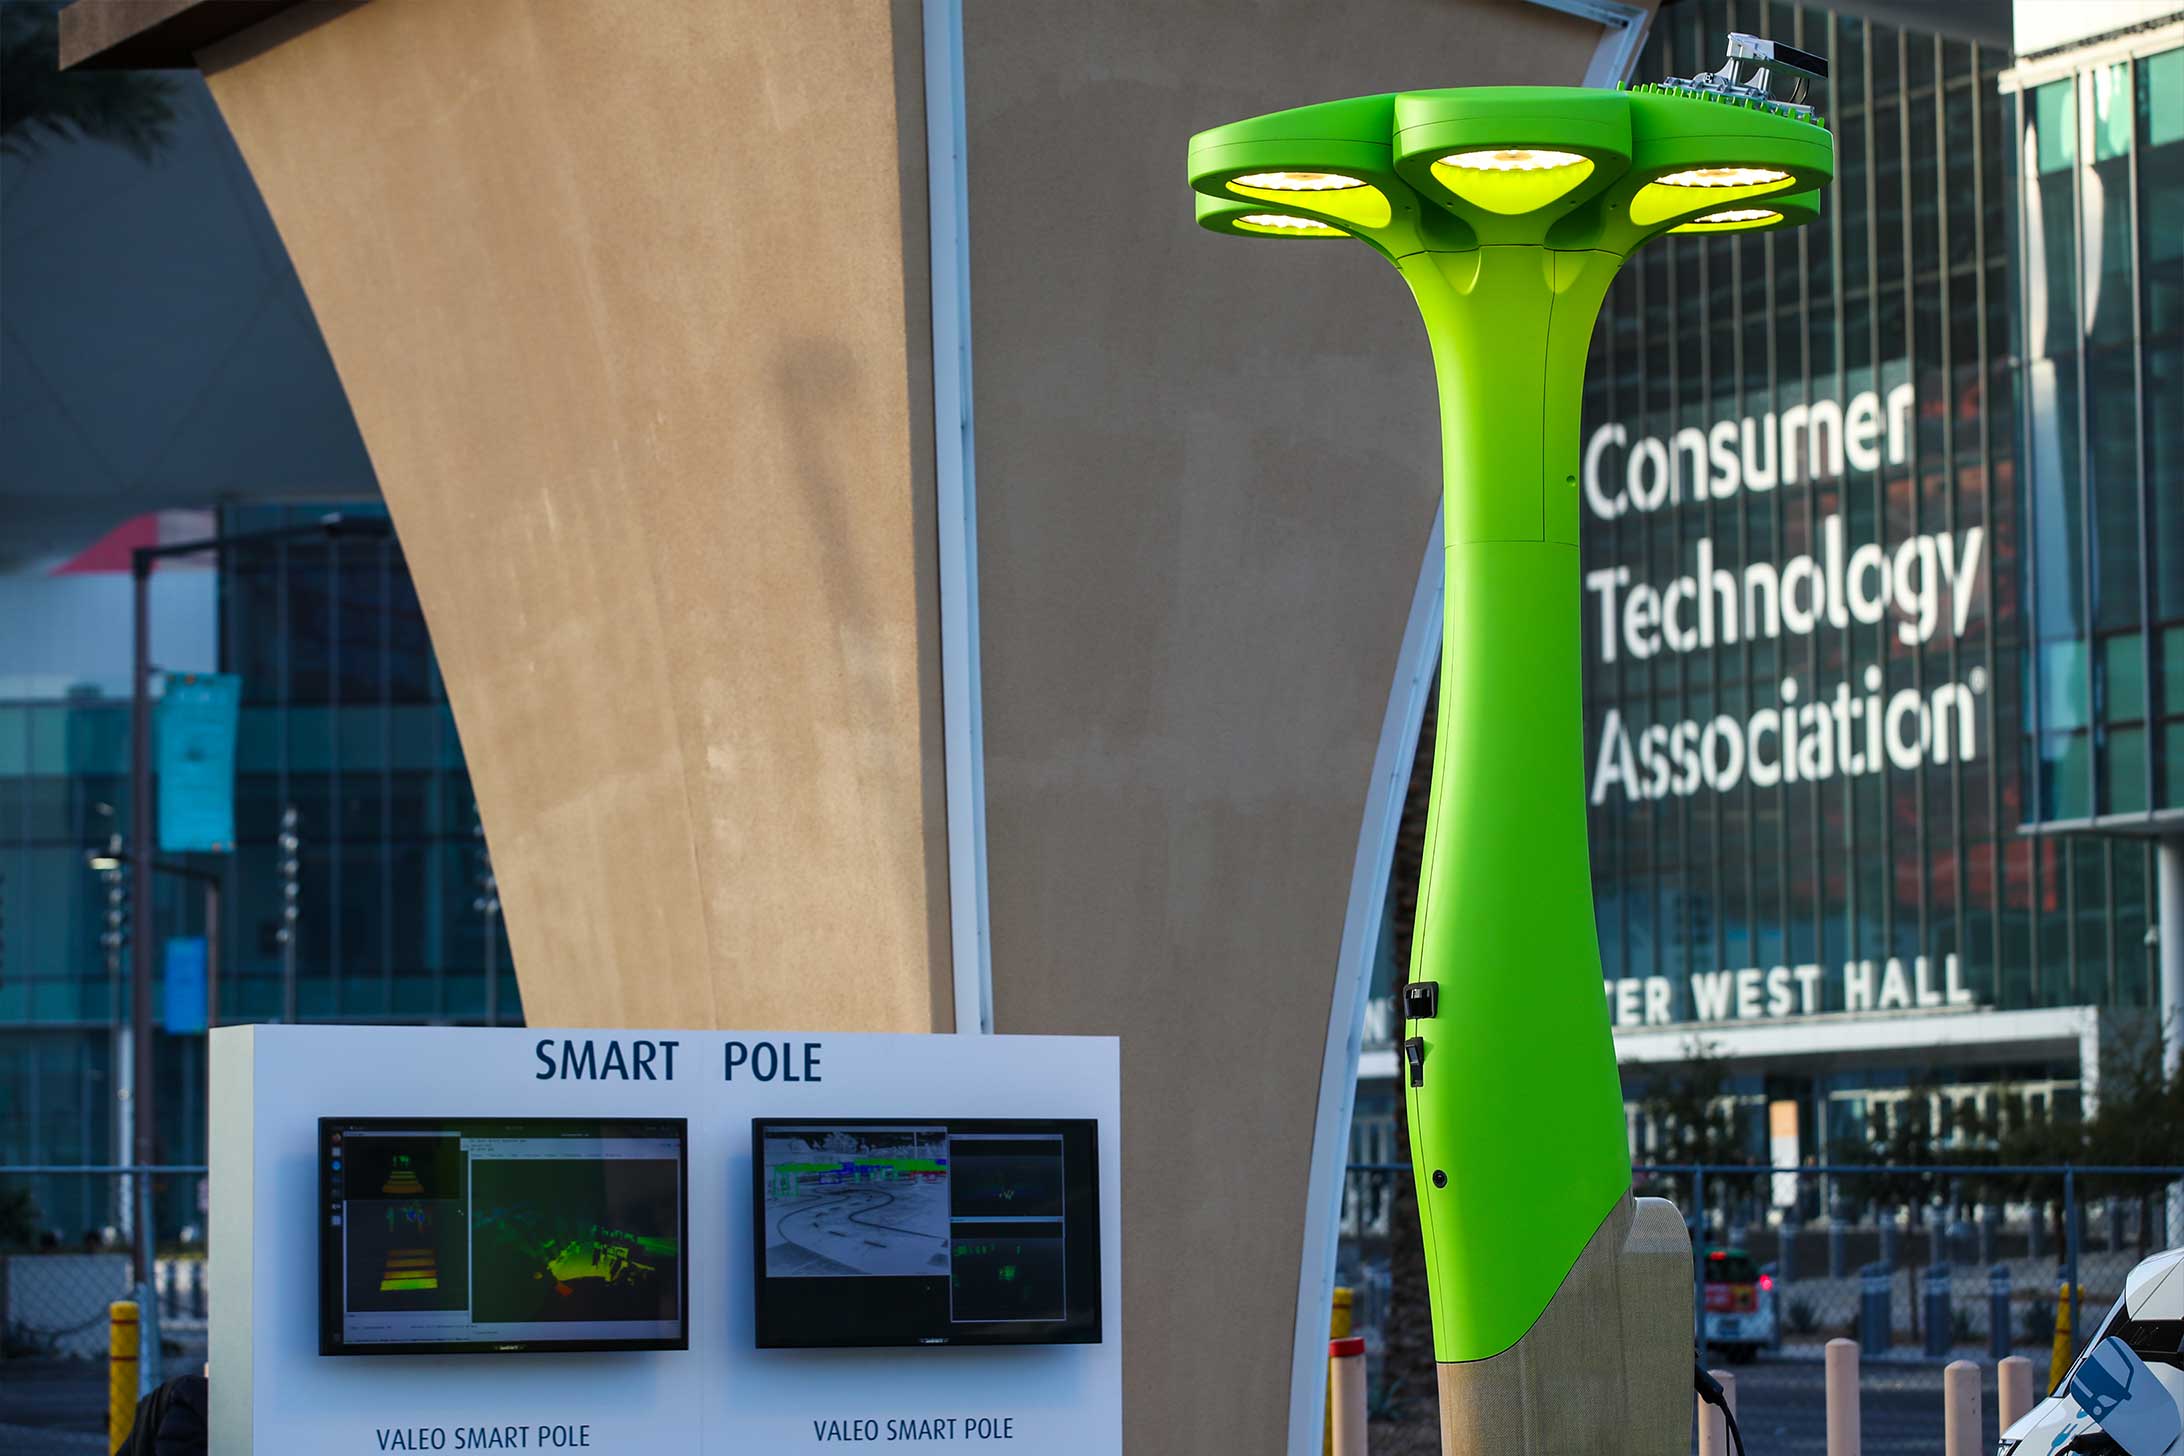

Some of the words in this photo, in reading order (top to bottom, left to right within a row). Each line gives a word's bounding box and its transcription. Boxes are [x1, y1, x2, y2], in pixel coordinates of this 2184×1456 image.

[1584, 382, 1916, 520] Consumer
[1586, 514, 1985, 664] Technology
[1691, 963, 1823, 1020] WEST
[1843, 953, 1972, 1012] HALL
[535, 1038, 680, 1081] SMART
[724, 1041, 822, 1083] POLE
[376, 1427, 446, 1451] VALEO
[454, 1426, 530, 1450] SMART
[538, 1424, 591, 1448] POLE
[813, 1419, 879, 1442] VALEO
[886, 1418, 957, 1441] SMART
[964, 1417, 1013, 1440] POLE
